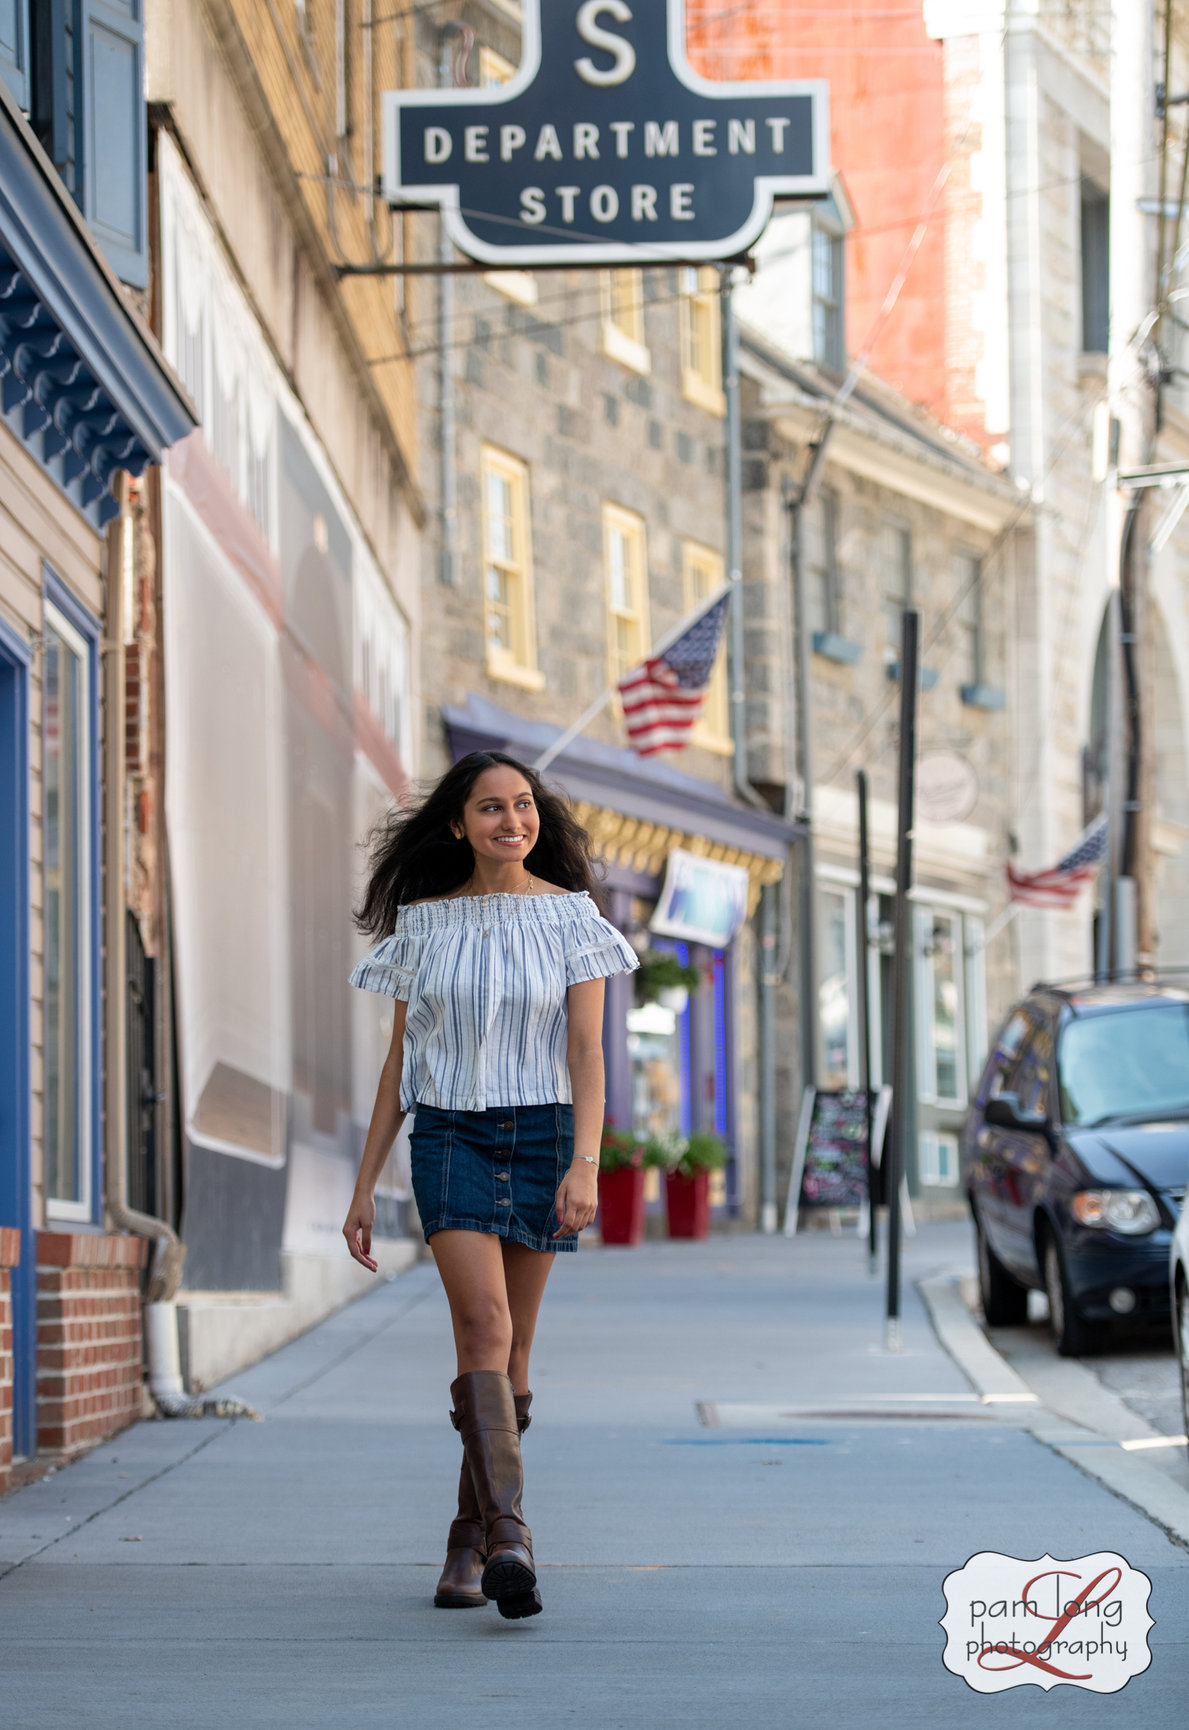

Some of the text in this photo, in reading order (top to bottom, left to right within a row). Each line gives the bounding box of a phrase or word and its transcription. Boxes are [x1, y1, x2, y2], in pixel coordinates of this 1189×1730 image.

[575, 0, 637, 86] S
[424, 118, 790, 163] DEPARTMENT
[520, 183, 695, 225] STORE
